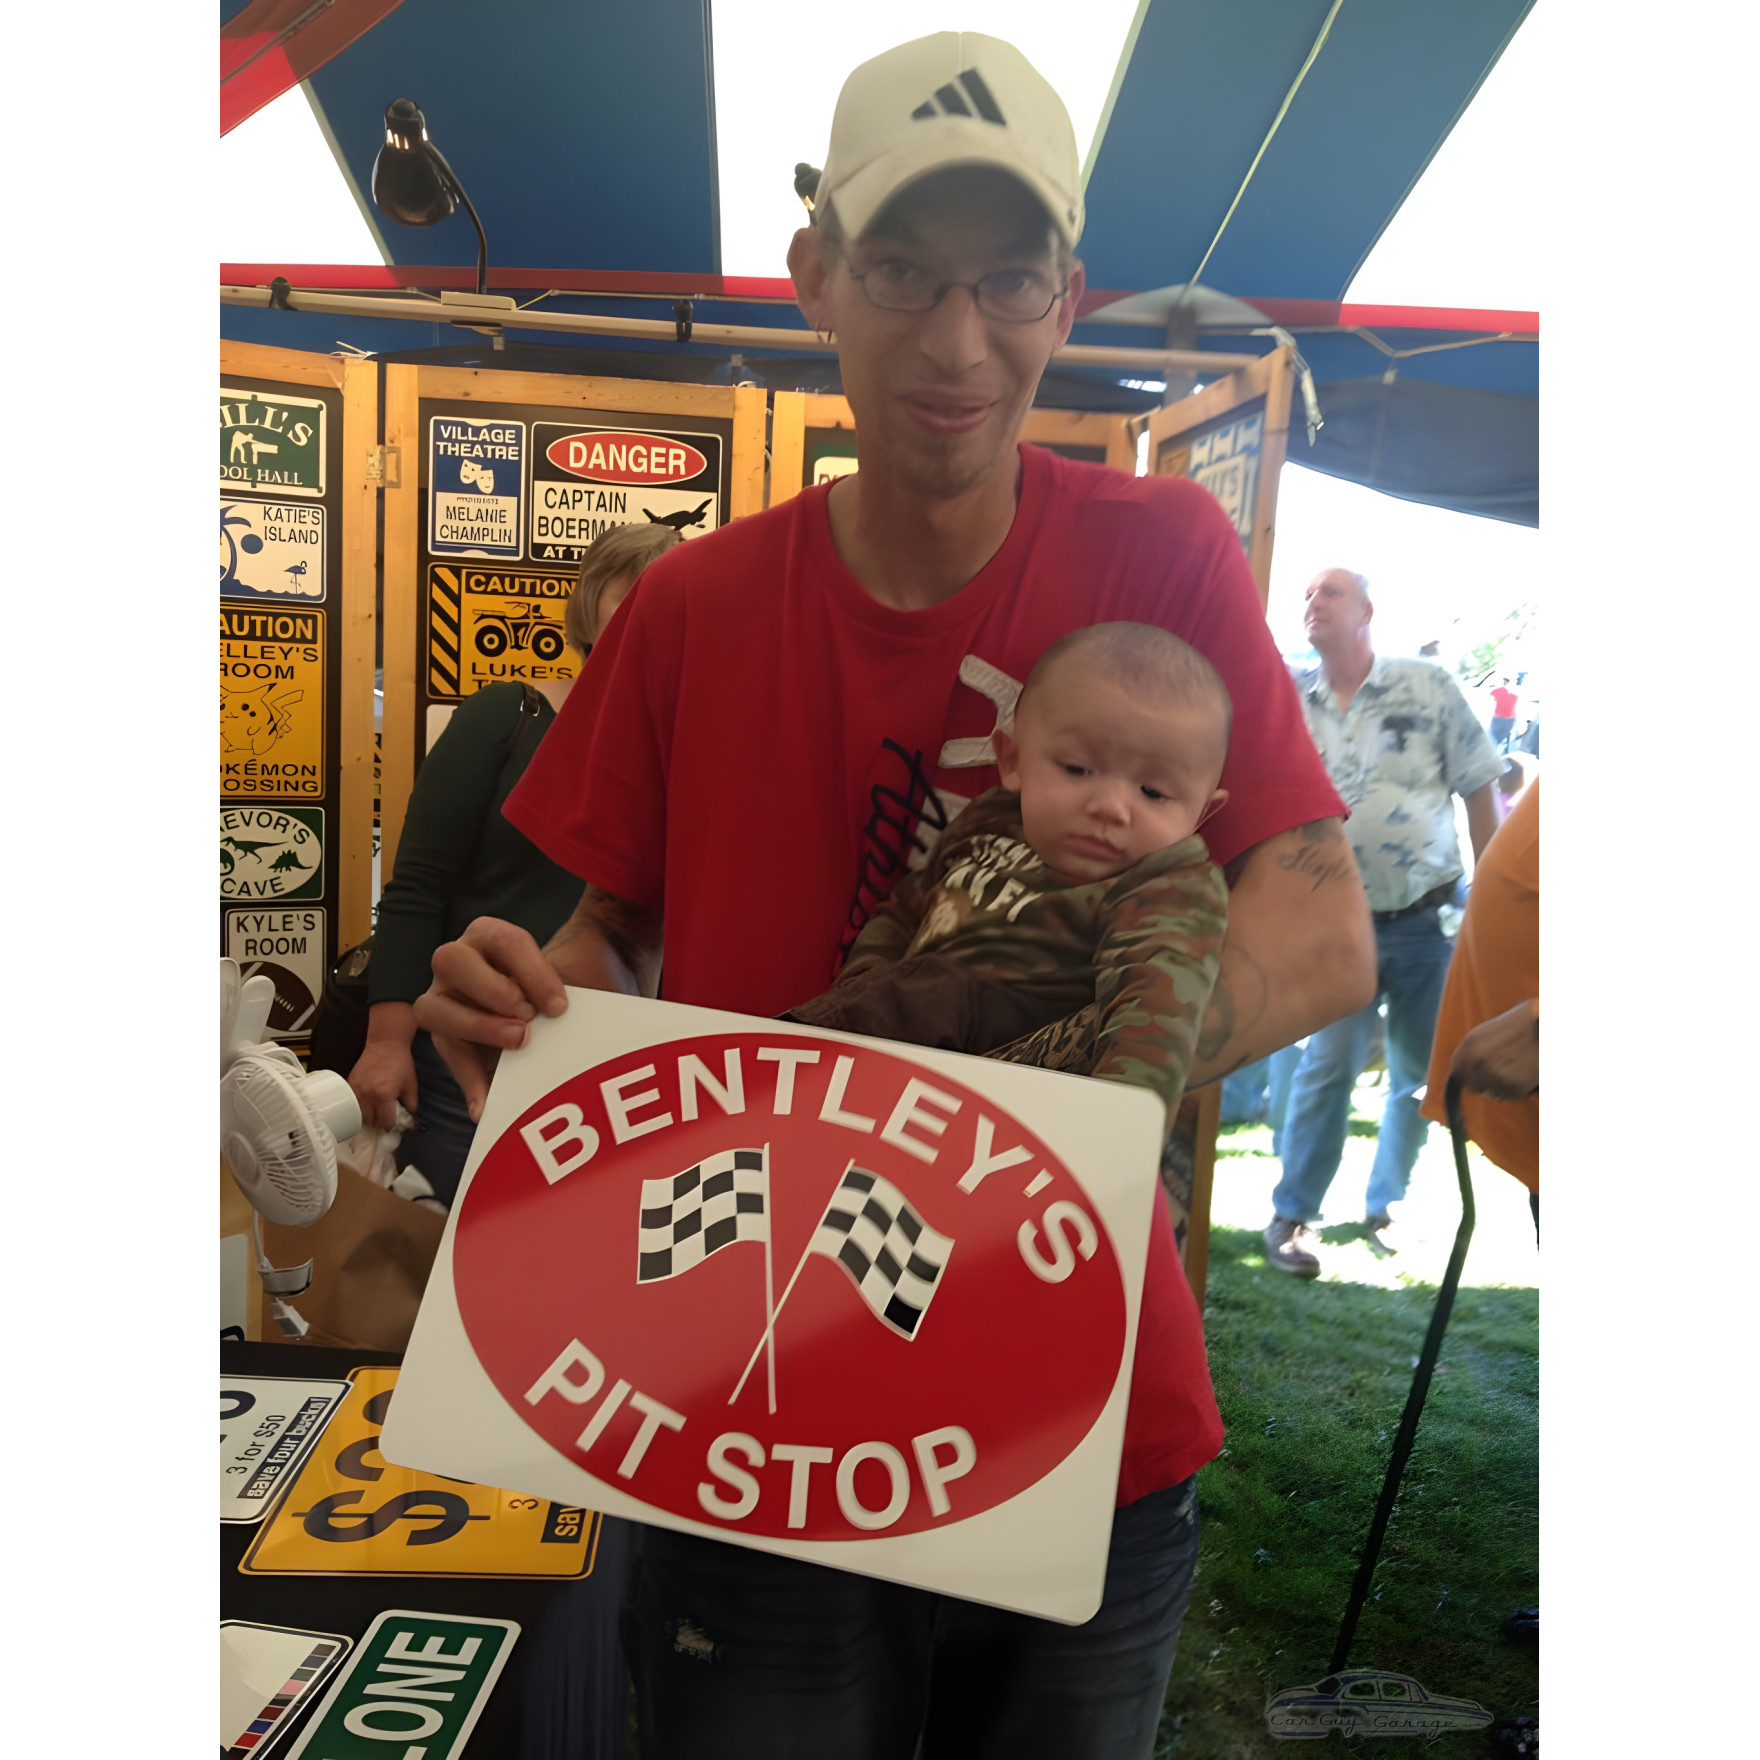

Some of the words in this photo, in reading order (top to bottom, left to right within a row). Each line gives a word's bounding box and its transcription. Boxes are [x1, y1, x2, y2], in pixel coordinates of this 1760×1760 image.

[219, 403, 314, 447] ILL'S
[440, 425, 516, 443] VILLAGE
[436, 442, 519, 460] THEATRE
[568, 441, 687, 476] DANGER
[256, 468, 303, 485] HALL
[544, 487, 627, 514] CAPTAIN
[263, 505, 320, 526] KATIE'S
[446, 505, 508, 524] MELANIE
[264, 525, 319, 545] ISLAND
[439, 524, 513, 543] CHAMPLIN
[537, 515, 632, 541] BOERM
[542, 545, 567, 559] AT
[469, 574, 577, 597] CAUTION
[219, 643, 318, 662] LLEY'S
[471, 662, 573, 679] LUKE'S
[219, 759, 317, 777] KÉMON
[219, 810, 310, 845] EVOR'S
[220, 876, 285, 897] CAVE
[236, 913, 316, 933] KYLE'S
[245, 937, 307, 956] ROOM
[519, 1046, 1099, 1284] BENTLEY'S
[523, 1337, 687, 1480] PIT
[697, 1425, 977, 1531] STOP
[234, 1441, 266, 1462] for
[225, 1465, 248, 1475] 3
[507, 1498, 540, 1511] 3
[322, 1631, 483, 1760] ONE
